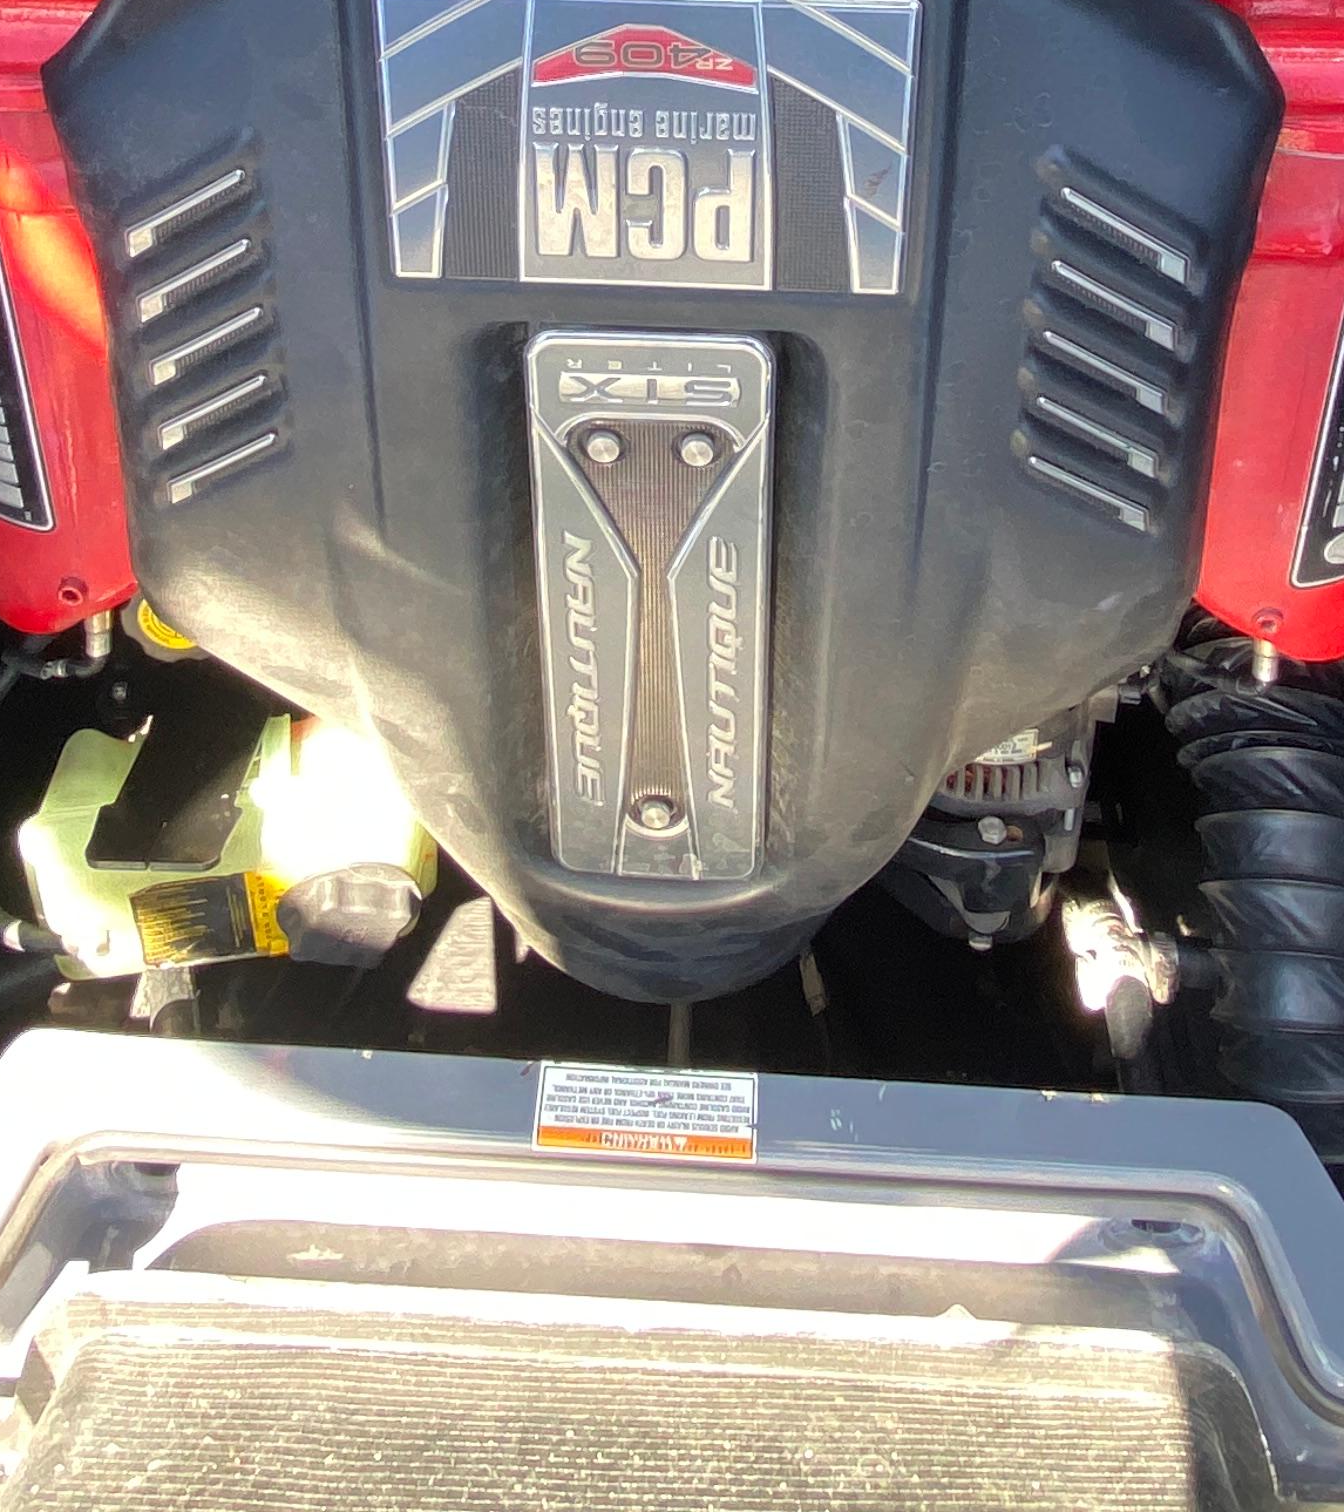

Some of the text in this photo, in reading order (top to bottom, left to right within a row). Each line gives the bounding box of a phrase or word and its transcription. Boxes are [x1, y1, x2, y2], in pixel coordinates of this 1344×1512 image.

[574, 40, 713, 68] 409
[532, 101, 756, 144] marine engines
[534, 142, 755, 264] PCM
[566, 358, 732, 373] LITER
[561, 529, 607, 806] NAUTIQUE
[705, 535, 743, 809] NAUTIQUE
